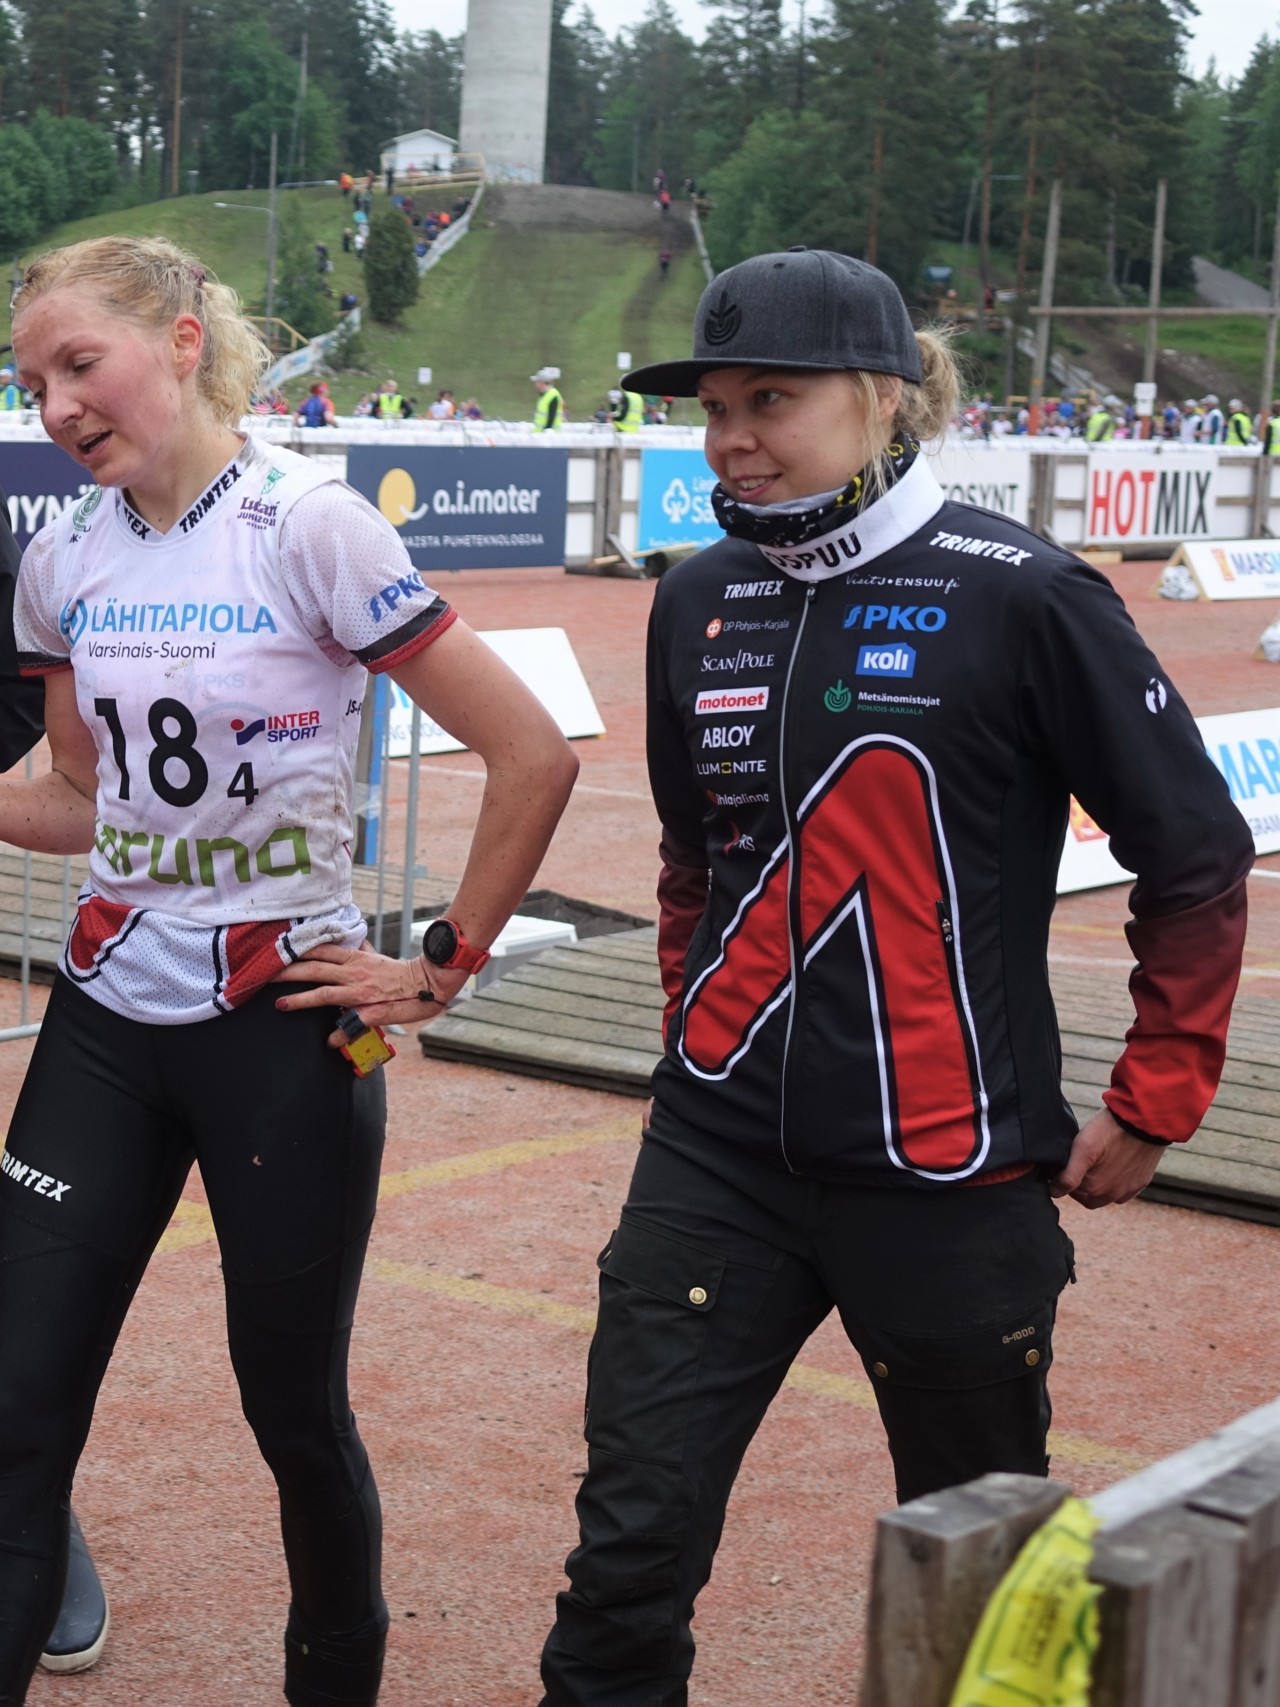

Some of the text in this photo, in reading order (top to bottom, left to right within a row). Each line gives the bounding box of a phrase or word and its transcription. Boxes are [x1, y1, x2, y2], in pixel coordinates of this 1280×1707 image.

[179, 463, 242, 533] TRIMTEX
[1089, 469, 1212, 537] HOTMIX
[929, 531, 1034, 566] TRIMTEX
[724, 580, 784, 600] TRIMTEX
[91, 597, 278, 634] LÄHITAPIOLA
[735, 619, 790, 632] Pohjois-Karjala
[88, 641, 217, 660] Varsinais-Suomi
[697, 691, 766, 711] motonet
[856, 703, 924, 716] POHJOIS-KARJALA
[857, 691, 941, 708] Metsänomistajat
[267, 710, 320, 730] INTER
[267, 725, 319, 743] SPORT
[701, 724, 756, 749] ABLOY
[94, 697, 209, 808] 18
[227, 762, 259, 806] 4
[715, 793, 770, 808] ihlajalinna
[1, 1148, 72, 1202] RIMTEX
[1001, 1326, 1036, 1345] G-1000
